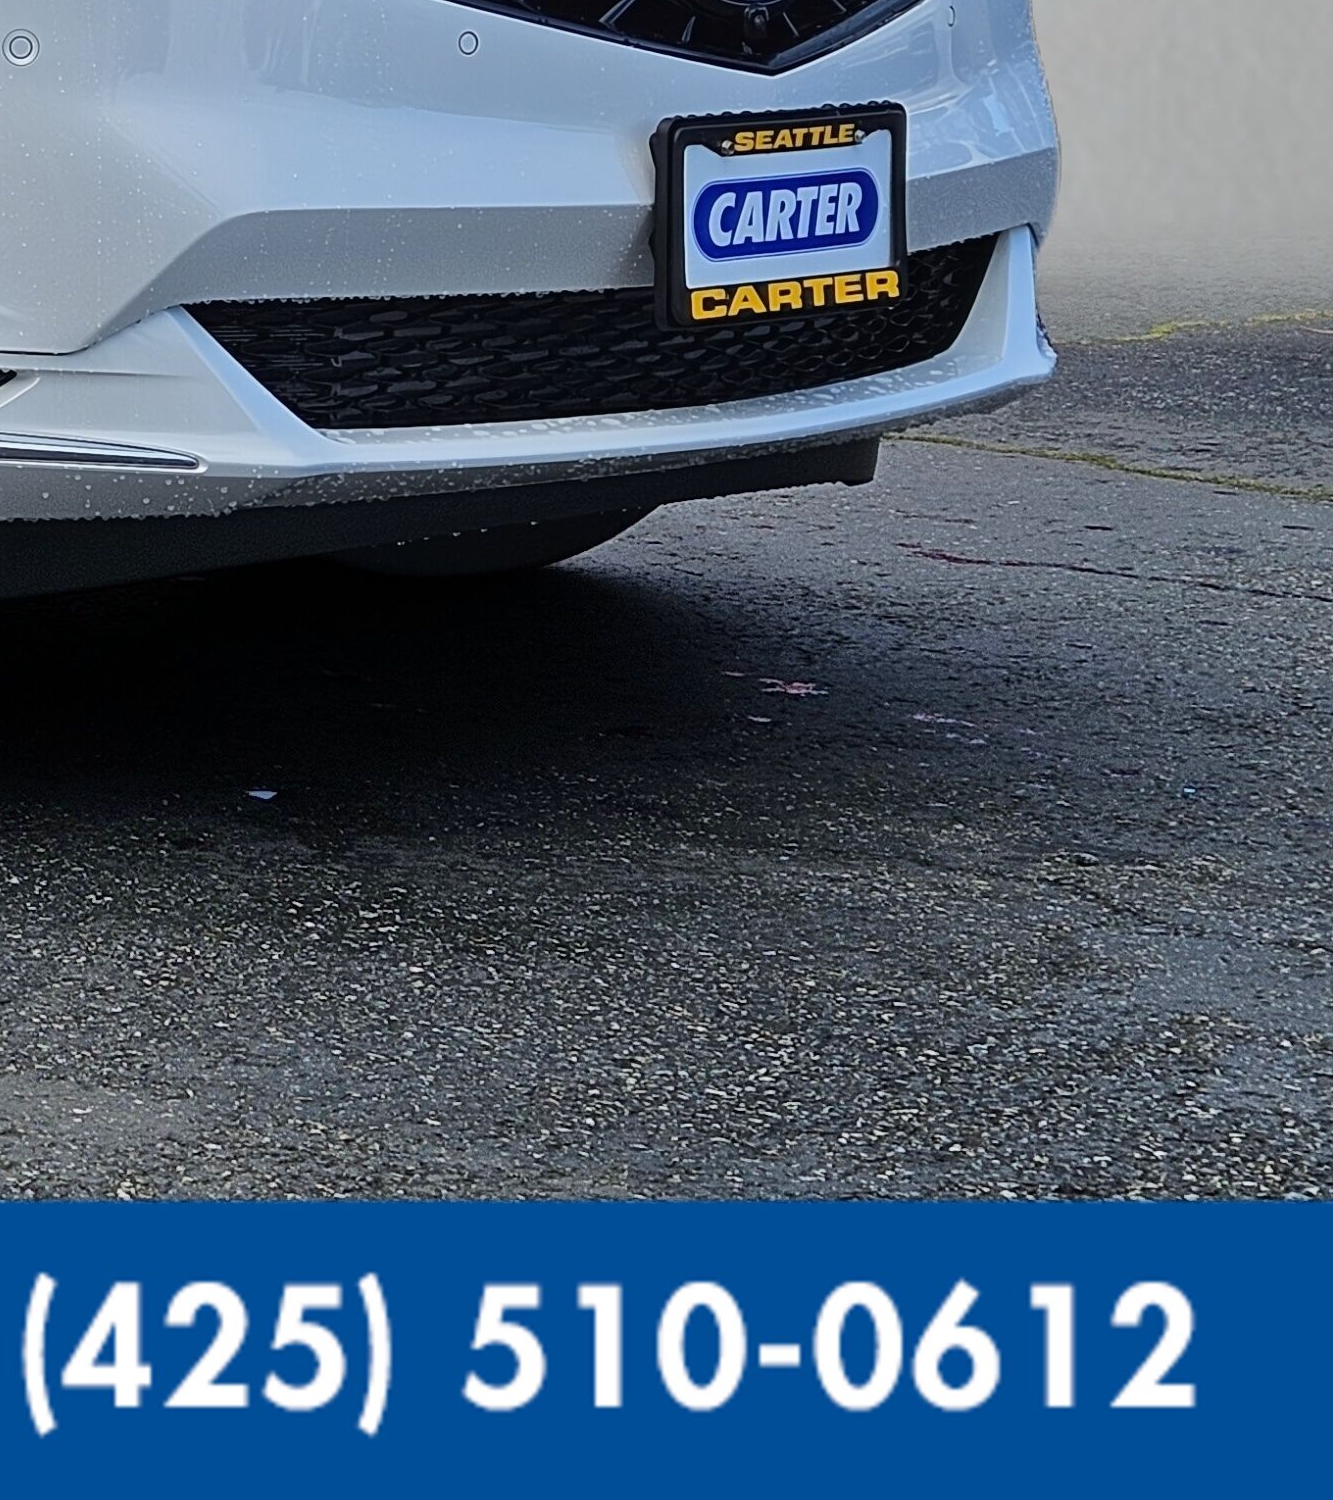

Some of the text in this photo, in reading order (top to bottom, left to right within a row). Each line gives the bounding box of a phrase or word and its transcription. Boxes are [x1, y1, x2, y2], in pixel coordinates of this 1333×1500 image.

[734, 123, 856, 152] SEATTLE
[708, 182, 863, 247] CARTER
[690, 269, 901, 321] CARTER
